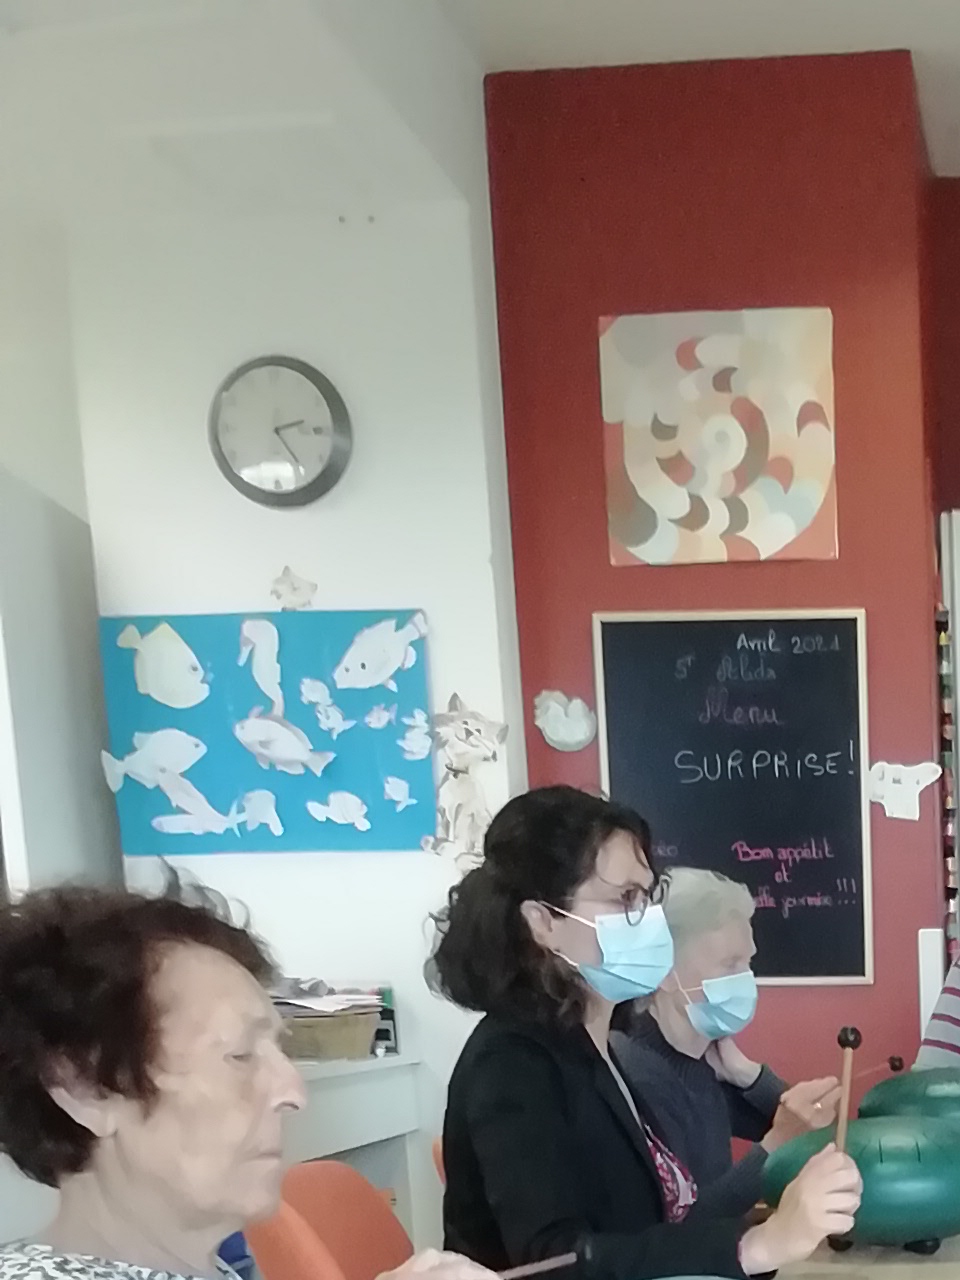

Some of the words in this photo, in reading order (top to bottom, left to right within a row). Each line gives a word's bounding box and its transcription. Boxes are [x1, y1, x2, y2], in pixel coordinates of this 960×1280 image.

[791, 634, 840, 654] 2021
[698, 686, 786, 725] Menu
[731, 840, 775, 861] Bon
[774, 862, 792, 883] et
